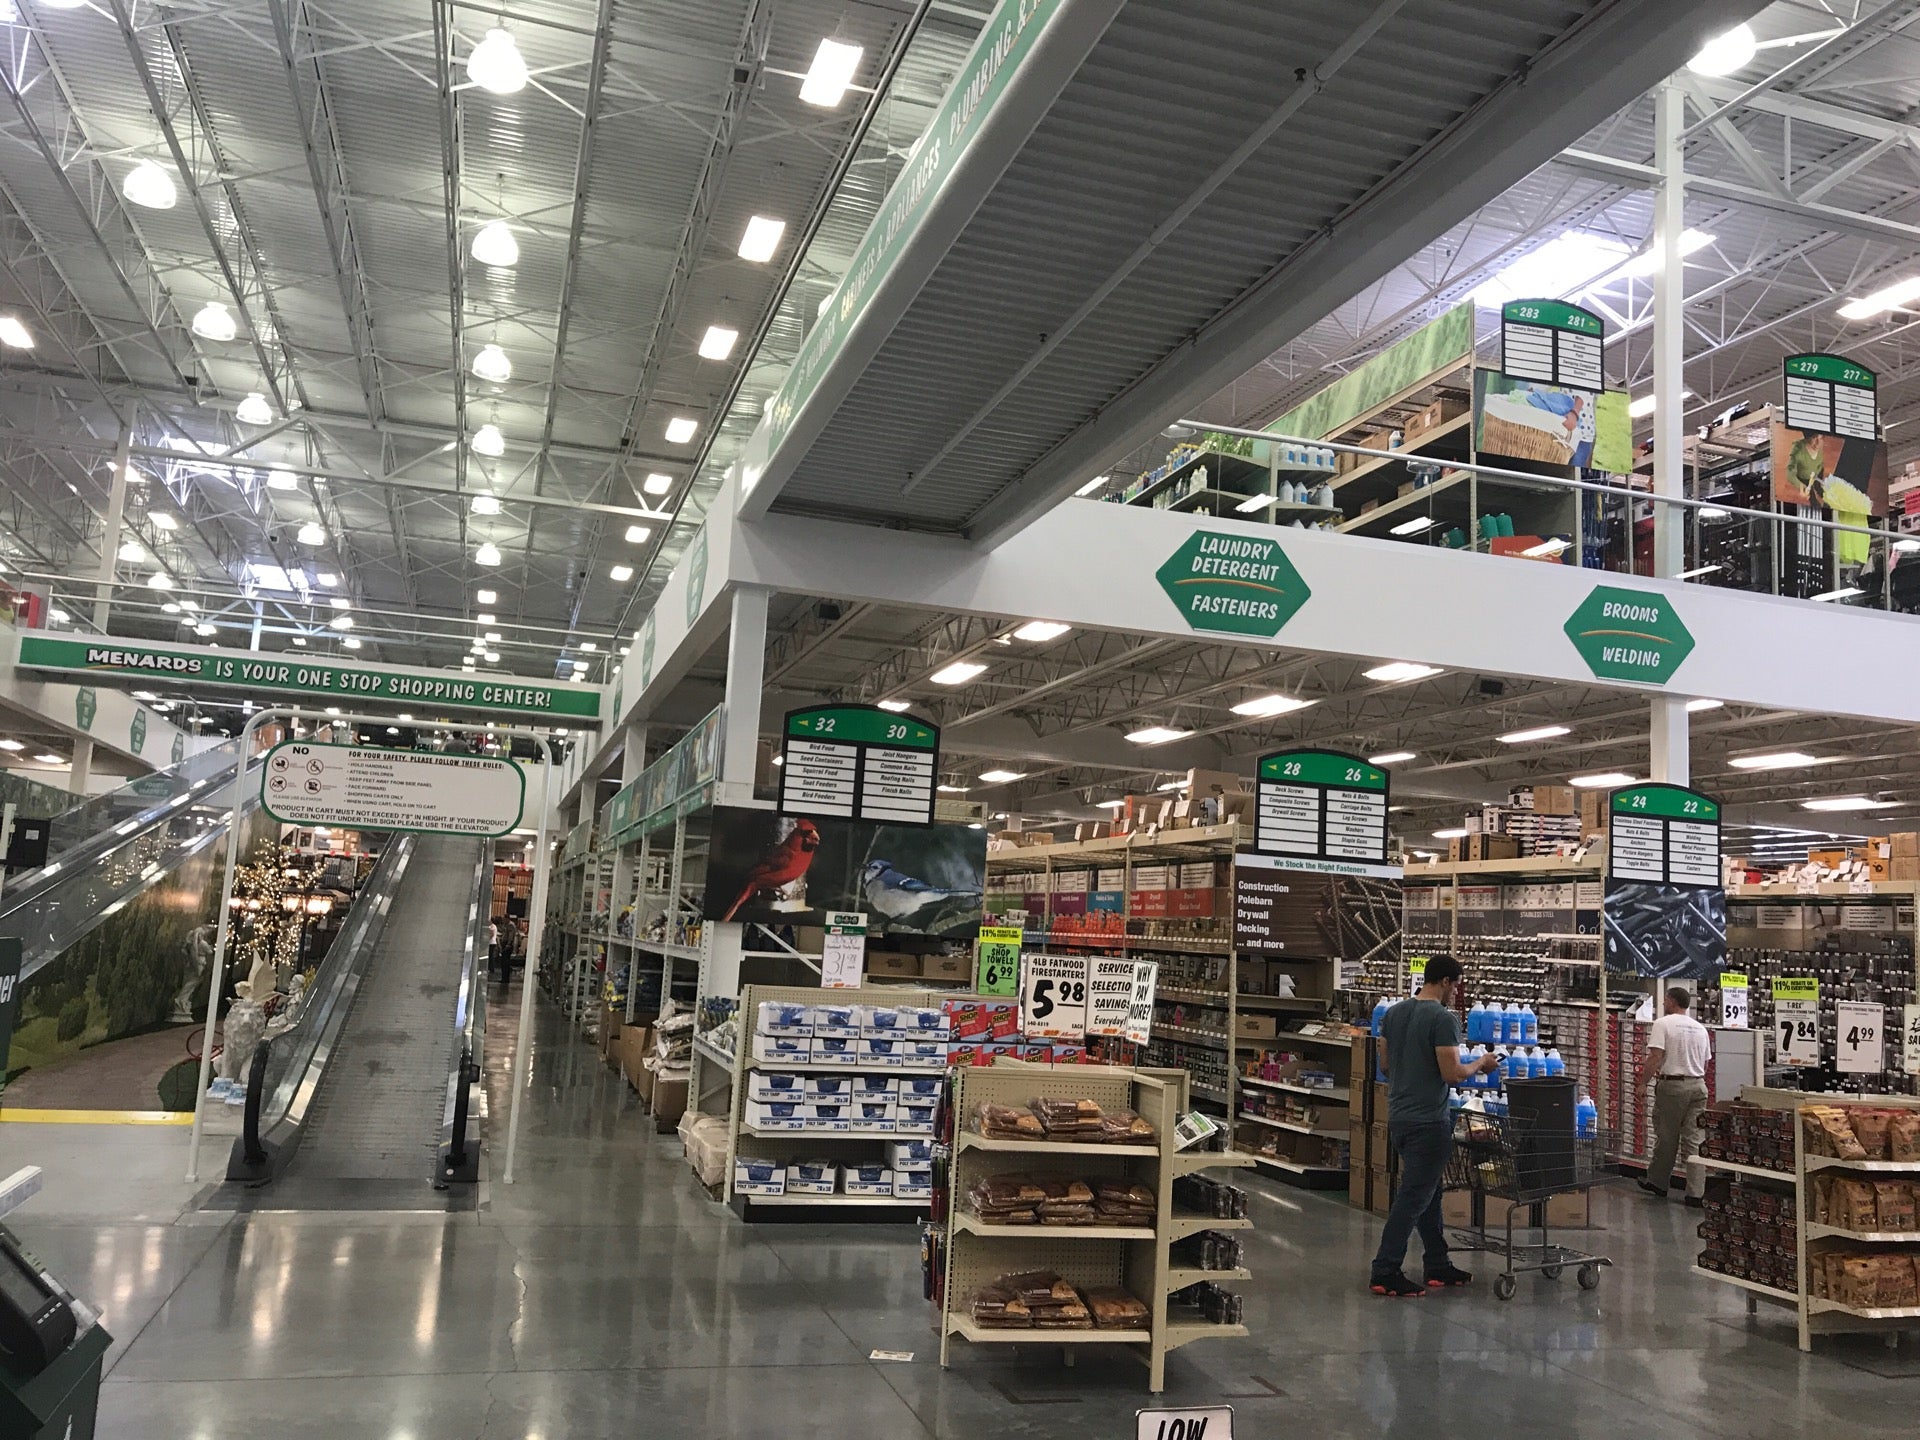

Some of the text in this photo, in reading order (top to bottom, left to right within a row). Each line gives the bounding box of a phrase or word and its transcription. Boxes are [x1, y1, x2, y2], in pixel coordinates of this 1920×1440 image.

[949, 19, 1012, 145] PLUMBING
[1519, 307, 1540, 319] 283
[1567, 315, 1586, 328] 281
[1800, 362, 1818, 373] 279
[1843, 369, 1861, 381] 277
[1199, 536, 1273, 561] LAUNDRY
[1191, 556, 1280, 582] DETERGENT
[1191, 594, 1278, 620] FASTENERS
[1602, 602, 1659, 623] BROOMS
[1602, 646, 1660, 667] WELDING
[87, 648, 552, 708] MENARDS IS YOUR ONE STOP SHOPPING CENTER!
[815, 717, 836, 733] 32
[886, 724, 907, 740] 30
[292, 746, 309, 755] NO
[821, 744, 835, 752] Food
[348, 750, 361, 758] FOR
[363, 751, 382, 759] YOUR
[410, 755, 433, 764] PLEASE
[435, 757, 460, 767] FOLLOW
[462, 760, 481, 768] THESE
[800, 754, 843, 765] Seed Containers
[895, 752, 917, 761] Hangers
[802, 766, 838, 777] Squirrel Food
[880, 762, 917, 772] Common Nails
[1283, 762, 1301, 776] 28
[880, 774, 915, 784] Roofing Nails
[1344, 768, 1362, 782] 26
[802, 791, 836, 801] Bird Feeders
[881, 786, 898, 795] Finish
[1287, 787, 1304, 795] Screws
[1293, 798, 1310, 807] Screws
[1631, 795, 1647, 808] 24
[1683, 800, 1698, 813] 22
[271, 804, 305, 812] PRODUCT
[315, 807, 334, 815] CART
[371, 811, 398, 819] EXCEED
[456, 817, 475, 825] YOUR
[476, 819, 508, 827] PRODUCT
[1271, 808, 1306, 818] Drywall Screws
[337, 815, 361, 823] UNDER
[379, 818, 396, 826] SIGN
[397, 819, 424, 828] PLEASE
[1351, 816, 1368, 824] Screws
[1273, 859, 1367, 875] We Stock the Right Fasteners
[1238, 880, 1289, 893] Construction
[1238, 894, 1273, 906] Polebarn
[1237, 909, 1269, 920] Drywall
[981, 928, 997, 938] 11%
[1237, 923, 1270, 936] Decking
[1246, 938, 1285, 950] and more
[991, 947, 1011, 957] SHOP
[986, 955, 1014, 965] TOWELS
[1032, 958, 1084, 969] 4LB FATWOOD
[1031, 968, 1085, 980] FIRESTARTERS
[1097, 962, 1134, 974] SERVICE
[1136, 965, 1153, 983] WHY
[985, 965, 1013, 986] 6 99
[1091, 980, 1132, 992] SELECTIO
[1774, 980, 1791, 991] 11%
[1032, 979, 1085, 1019] 5 98
[1134, 985, 1150, 1002] PAY
[959, 1012, 978, 1022] SHOP
[992, 1013, 1010, 1022] SHOP
[1128, 1003, 1151, 1021] MORE?
[1725, 1004, 1739, 1020] 59
[1780, 1021, 1816, 1052] 7 84
[1846, 1026, 1874, 1051] 4 99
